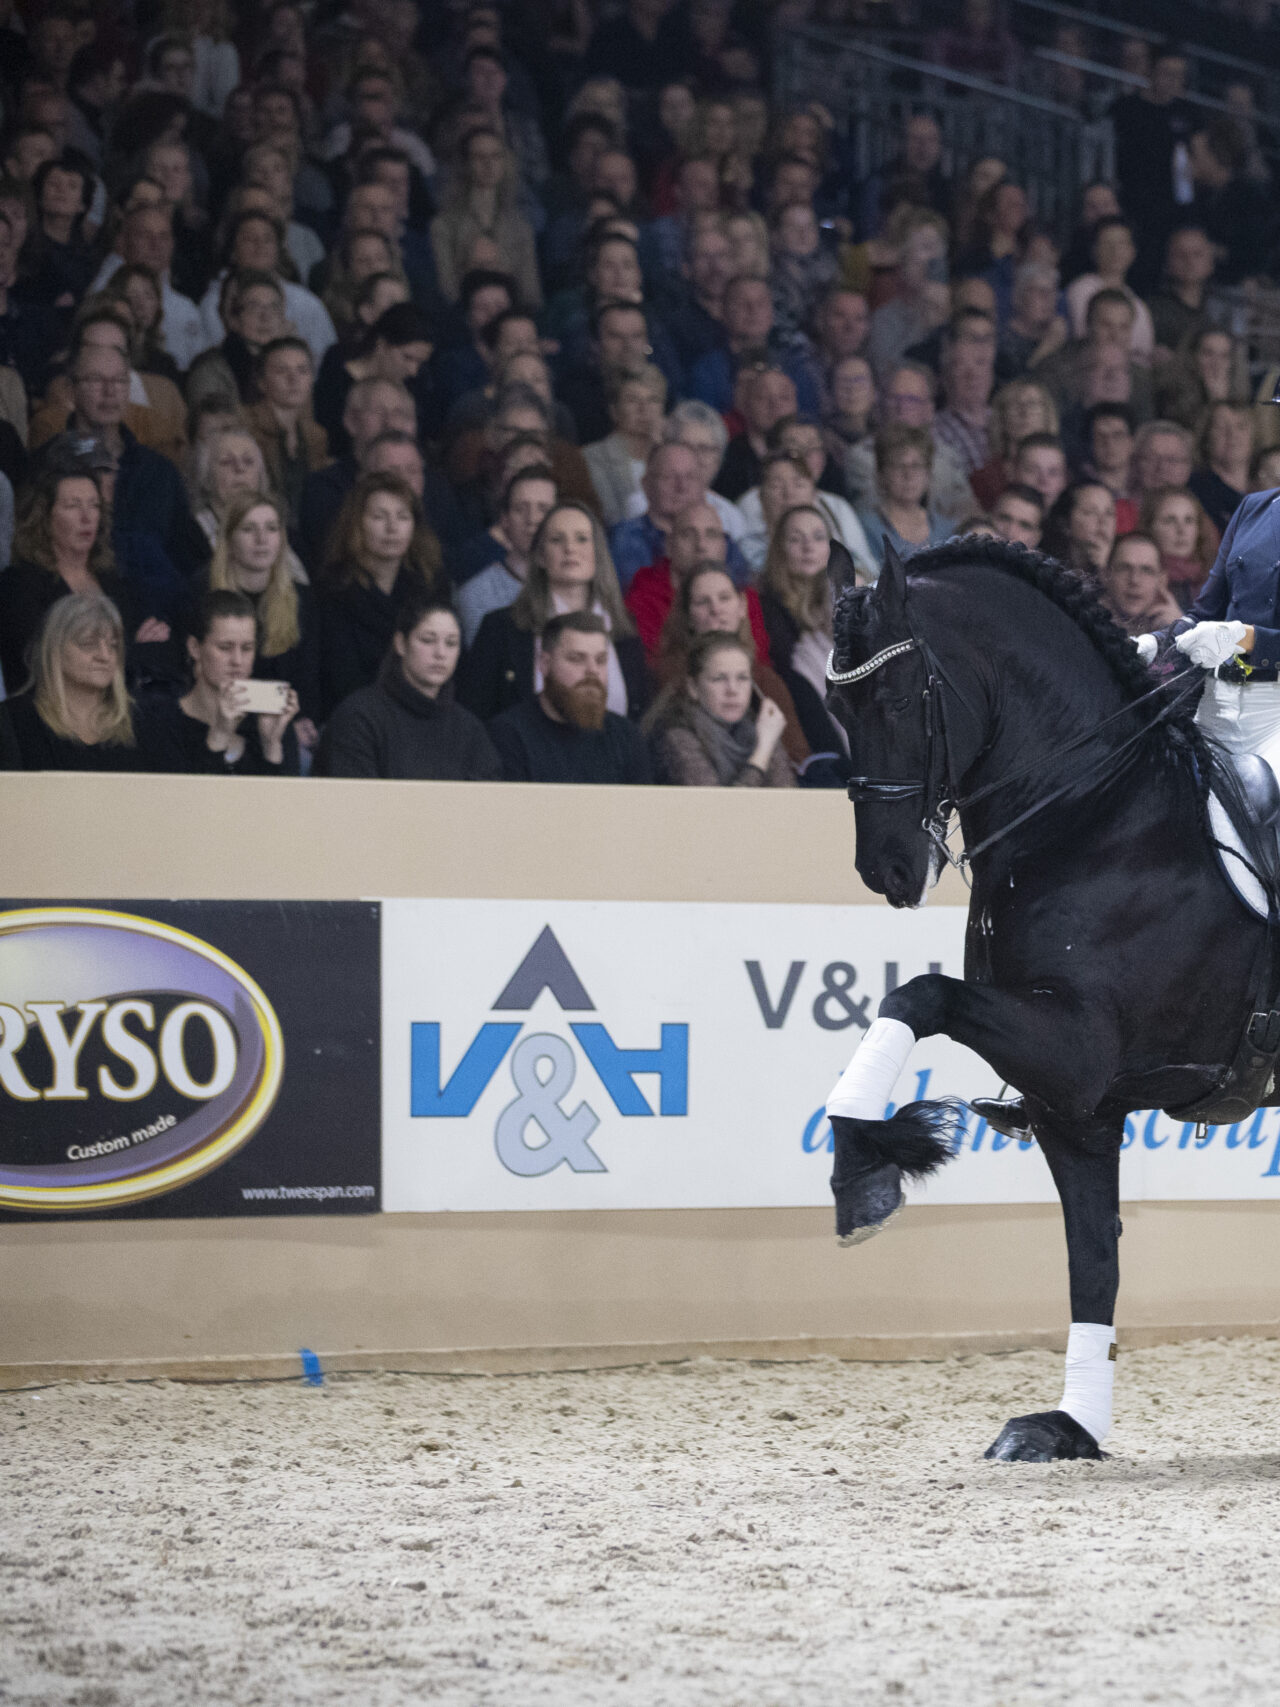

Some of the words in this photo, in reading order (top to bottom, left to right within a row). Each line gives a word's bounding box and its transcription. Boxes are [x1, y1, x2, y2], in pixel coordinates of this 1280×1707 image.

[67, 1136, 131, 1160] Custom
[131, 1114, 177, 1143] made
[241, 1185, 375, 1202] www.tweespan.com
